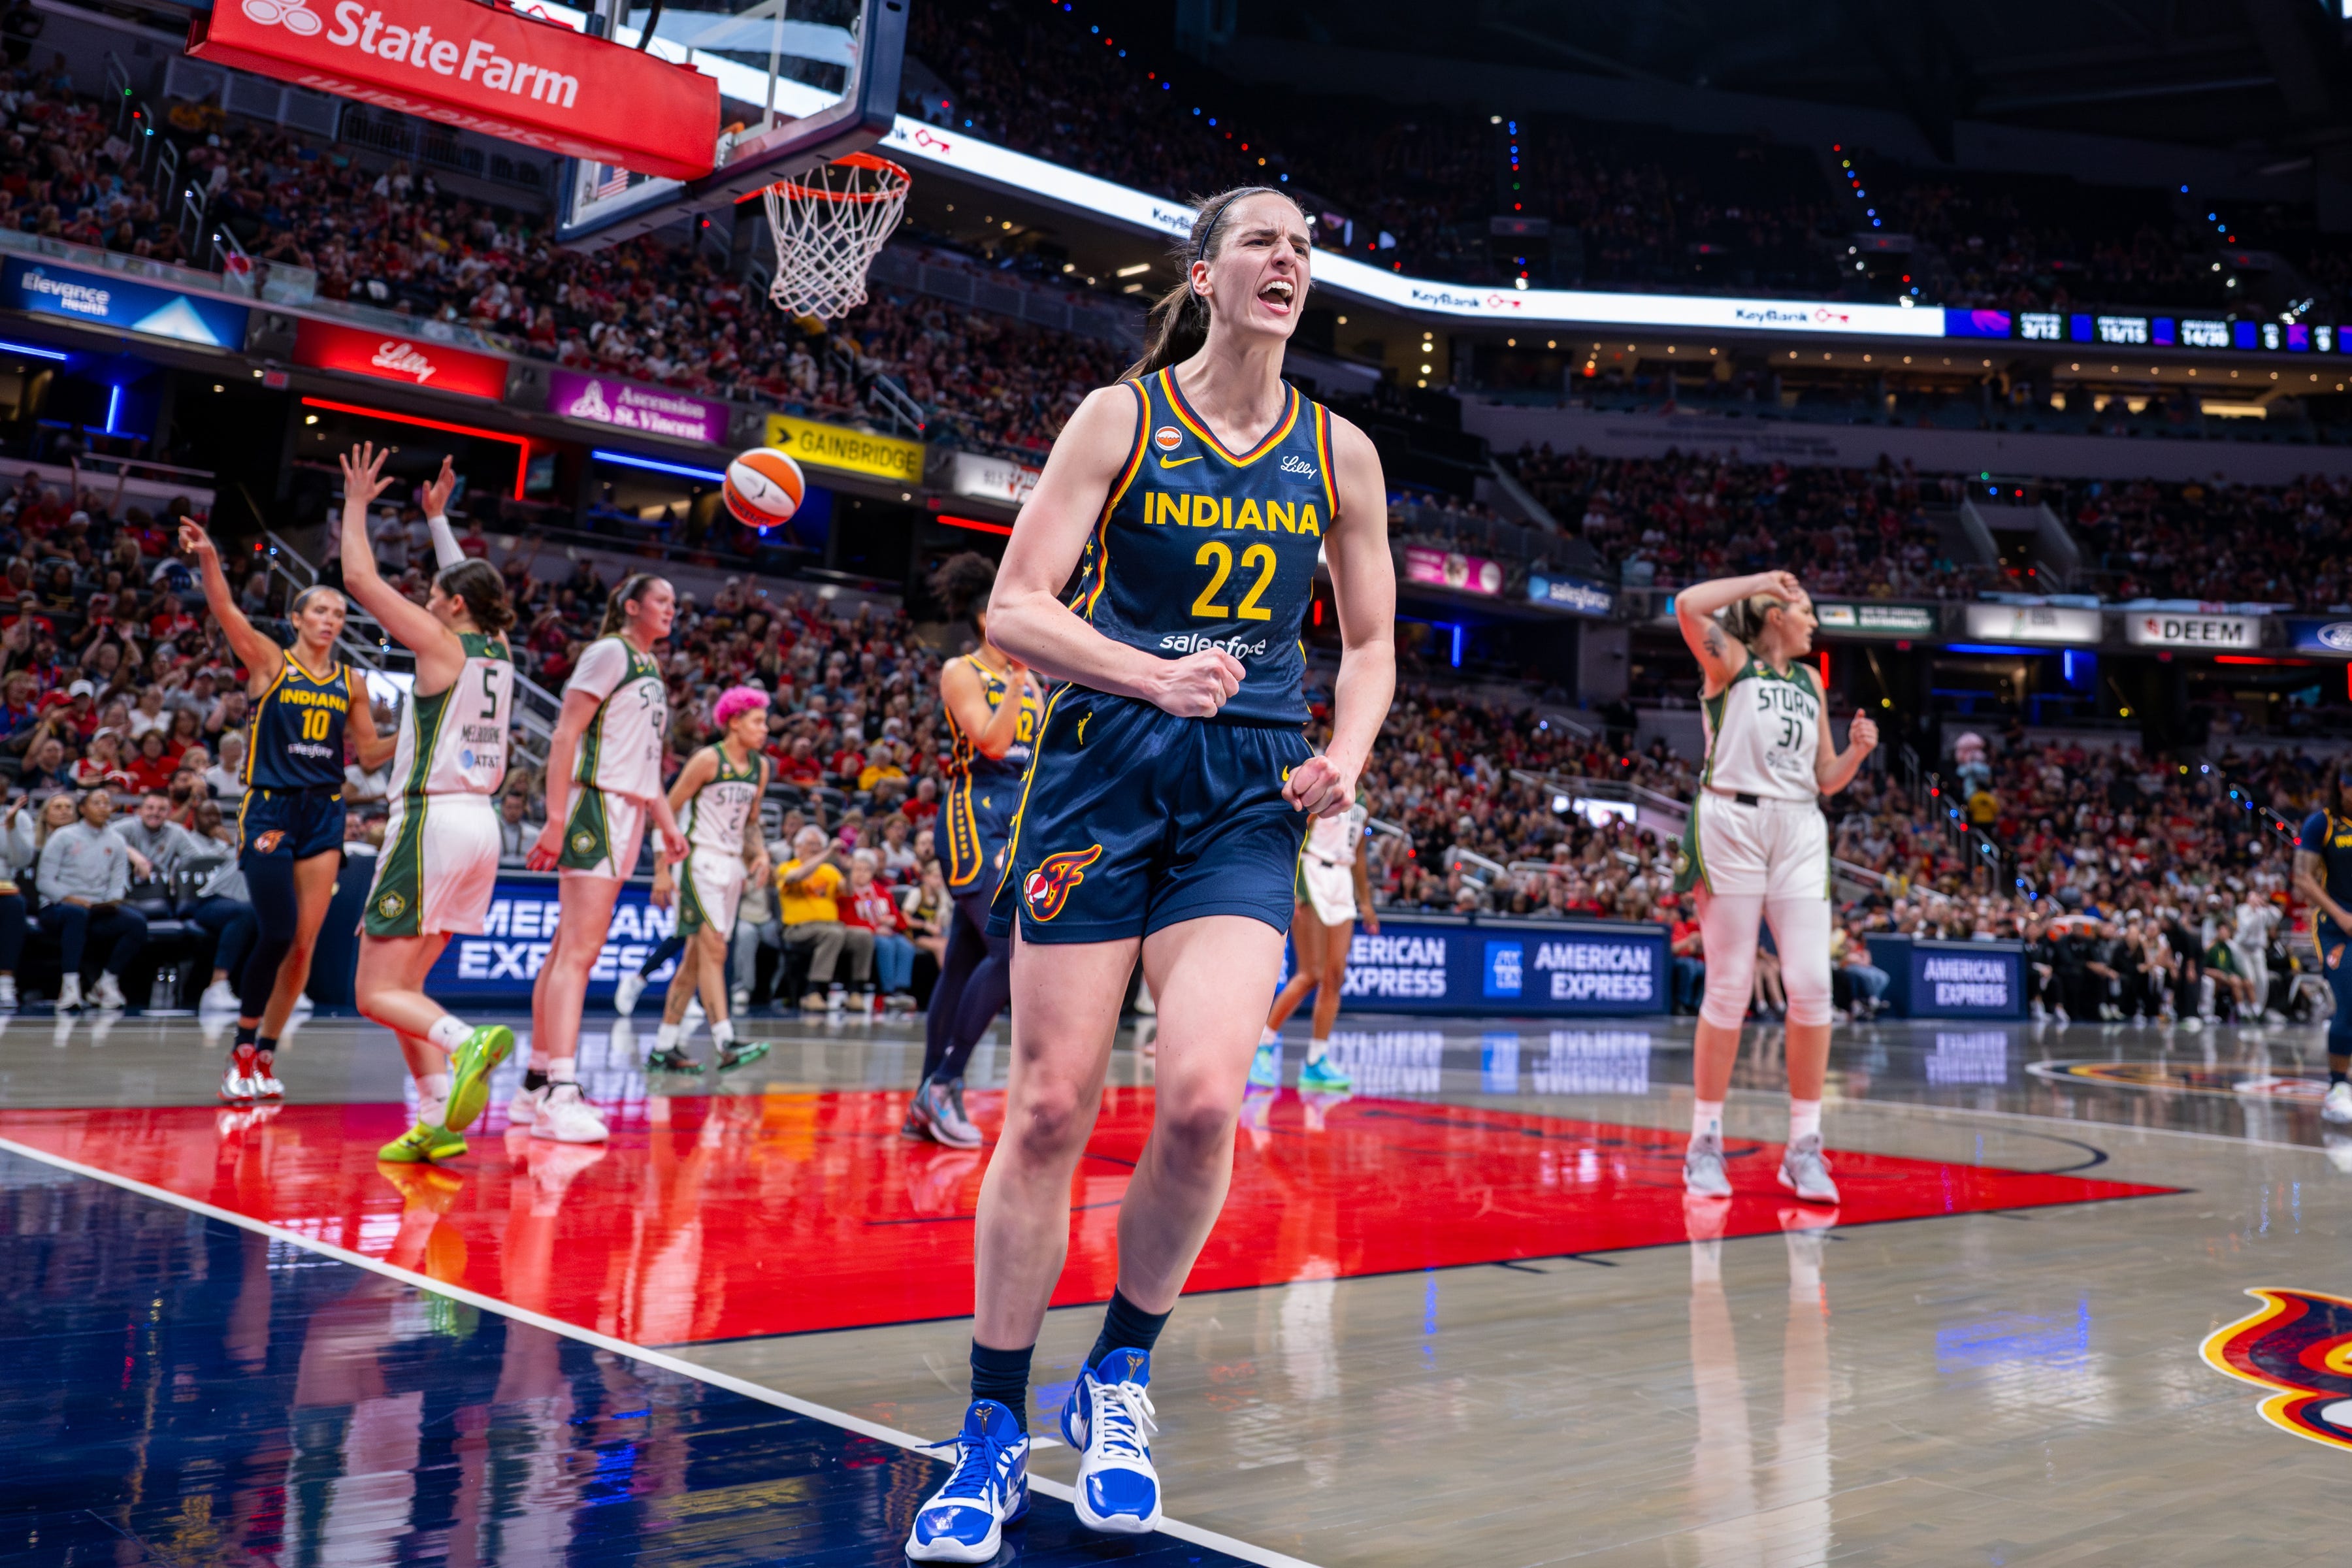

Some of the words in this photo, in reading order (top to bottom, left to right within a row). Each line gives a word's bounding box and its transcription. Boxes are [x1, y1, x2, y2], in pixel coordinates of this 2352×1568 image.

[22, 272, 111, 304] Elevance
[1412, 288, 1480, 308] KeyBank
[61, 297, 108, 317] Health
[1736, 309, 1808, 323] KeyBank
[372, 341, 436, 384] Lilly
[799, 430, 916, 472] GAINBRIDGE
[1281, 455, 1317, 480] Lilly
[1143, 491, 1320, 537] INDIANA
[1191, 542, 1277, 621] 22
[2164, 620, 2243, 642] DEEM
[1160, 633, 1266, 660] salesfoe
[279, 688, 348, 714] INDIANA
[480, 668, 497, 719] 5
[1758, 687, 1815, 721] STORM
[302, 708, 331, 741] 10
[1777, 717, 1802, 751] 31
[1349, 935, 1446, 966] ERICAN
[1534, 942, 1652, 972] AMERICAN
[1340, 966, 1446, 998] XPRESS
[1923, 958, 2006, 982] AMERICAN
[1551, 973, 1653, 1001] EXPRESS
[1935, 982, 2008, 1007] EXPRESS
